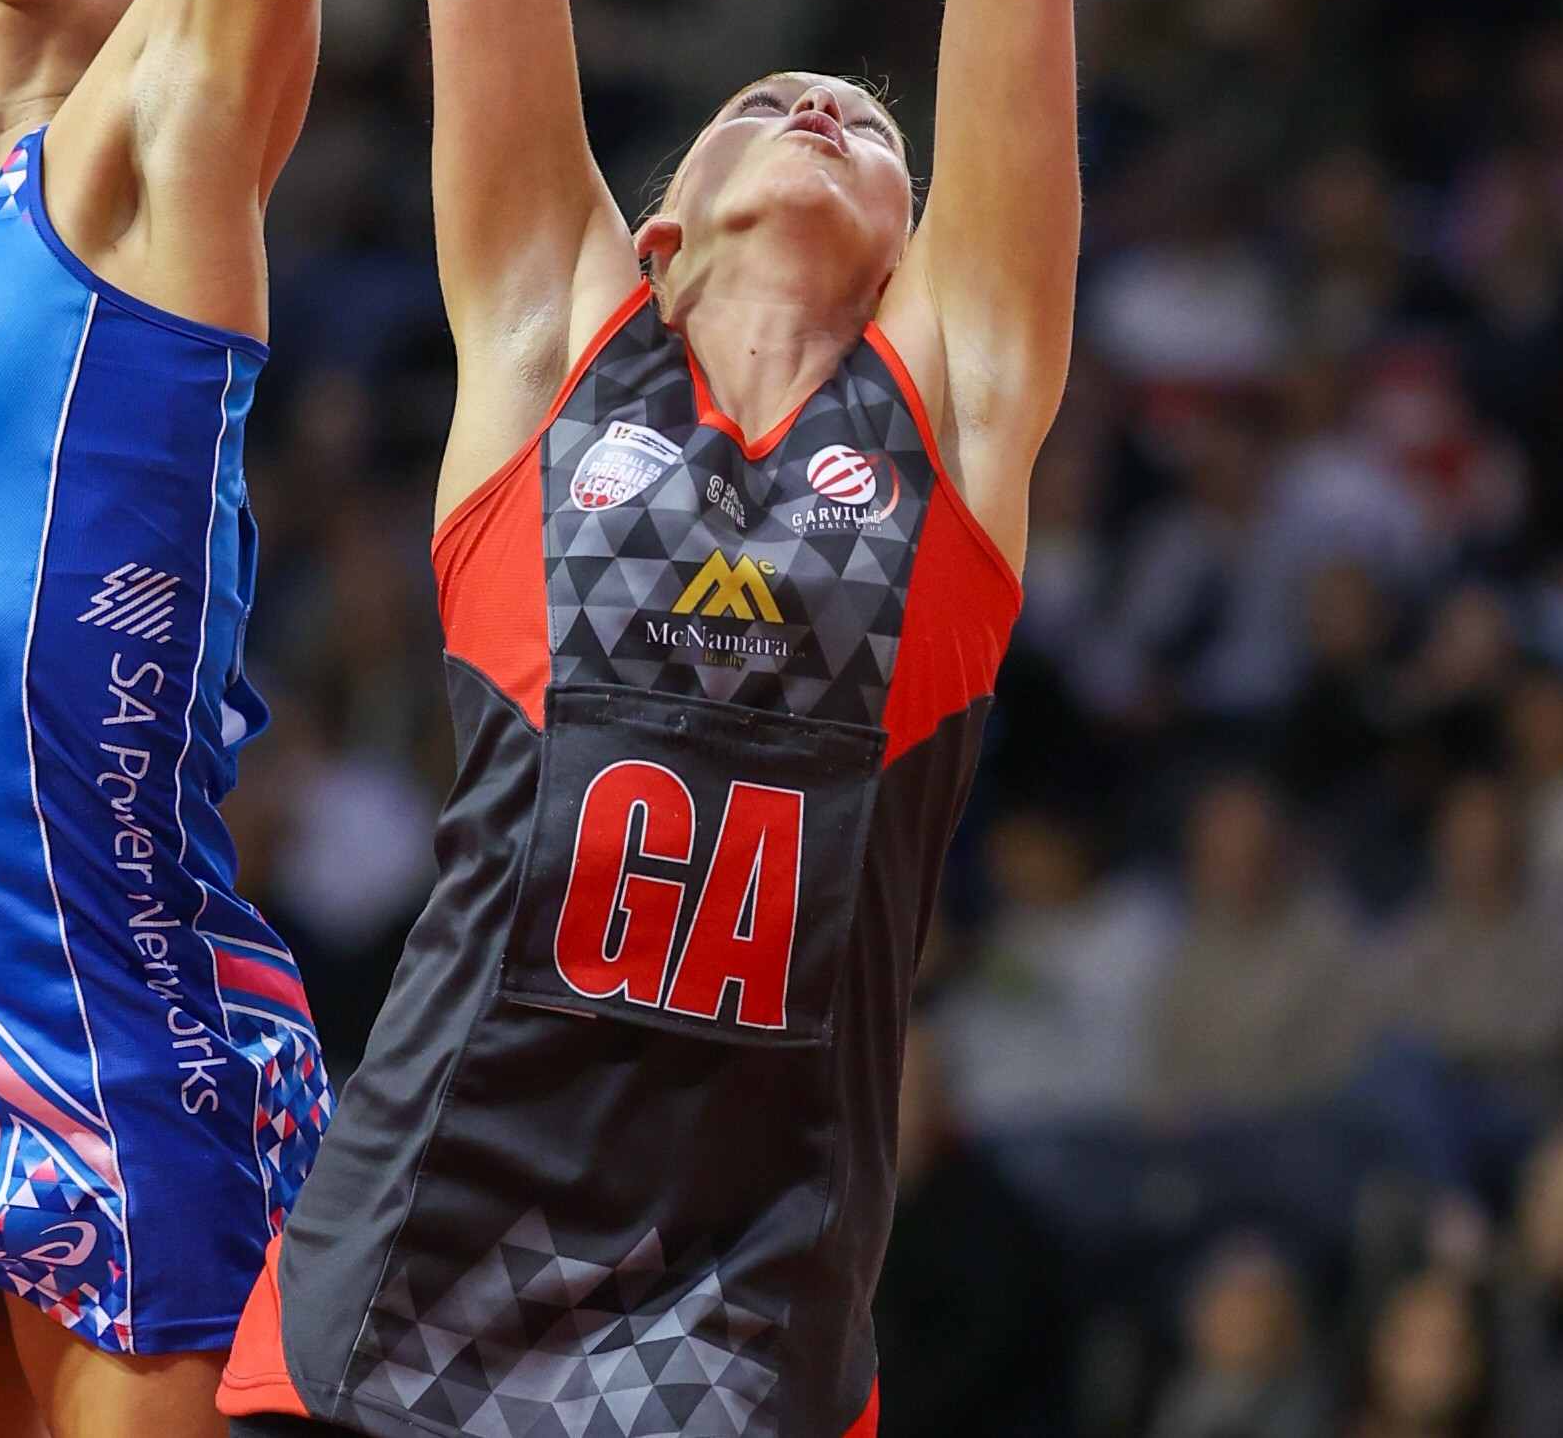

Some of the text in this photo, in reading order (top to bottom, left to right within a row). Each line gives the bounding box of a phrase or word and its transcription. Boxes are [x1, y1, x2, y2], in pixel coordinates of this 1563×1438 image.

[791, 505, 882, 528] GARVILLE
[645, 620, 789, 658] McNamara
[96, 652, 228, 1116] SA Power Networks
[553, 759, 805, 1030] GA
